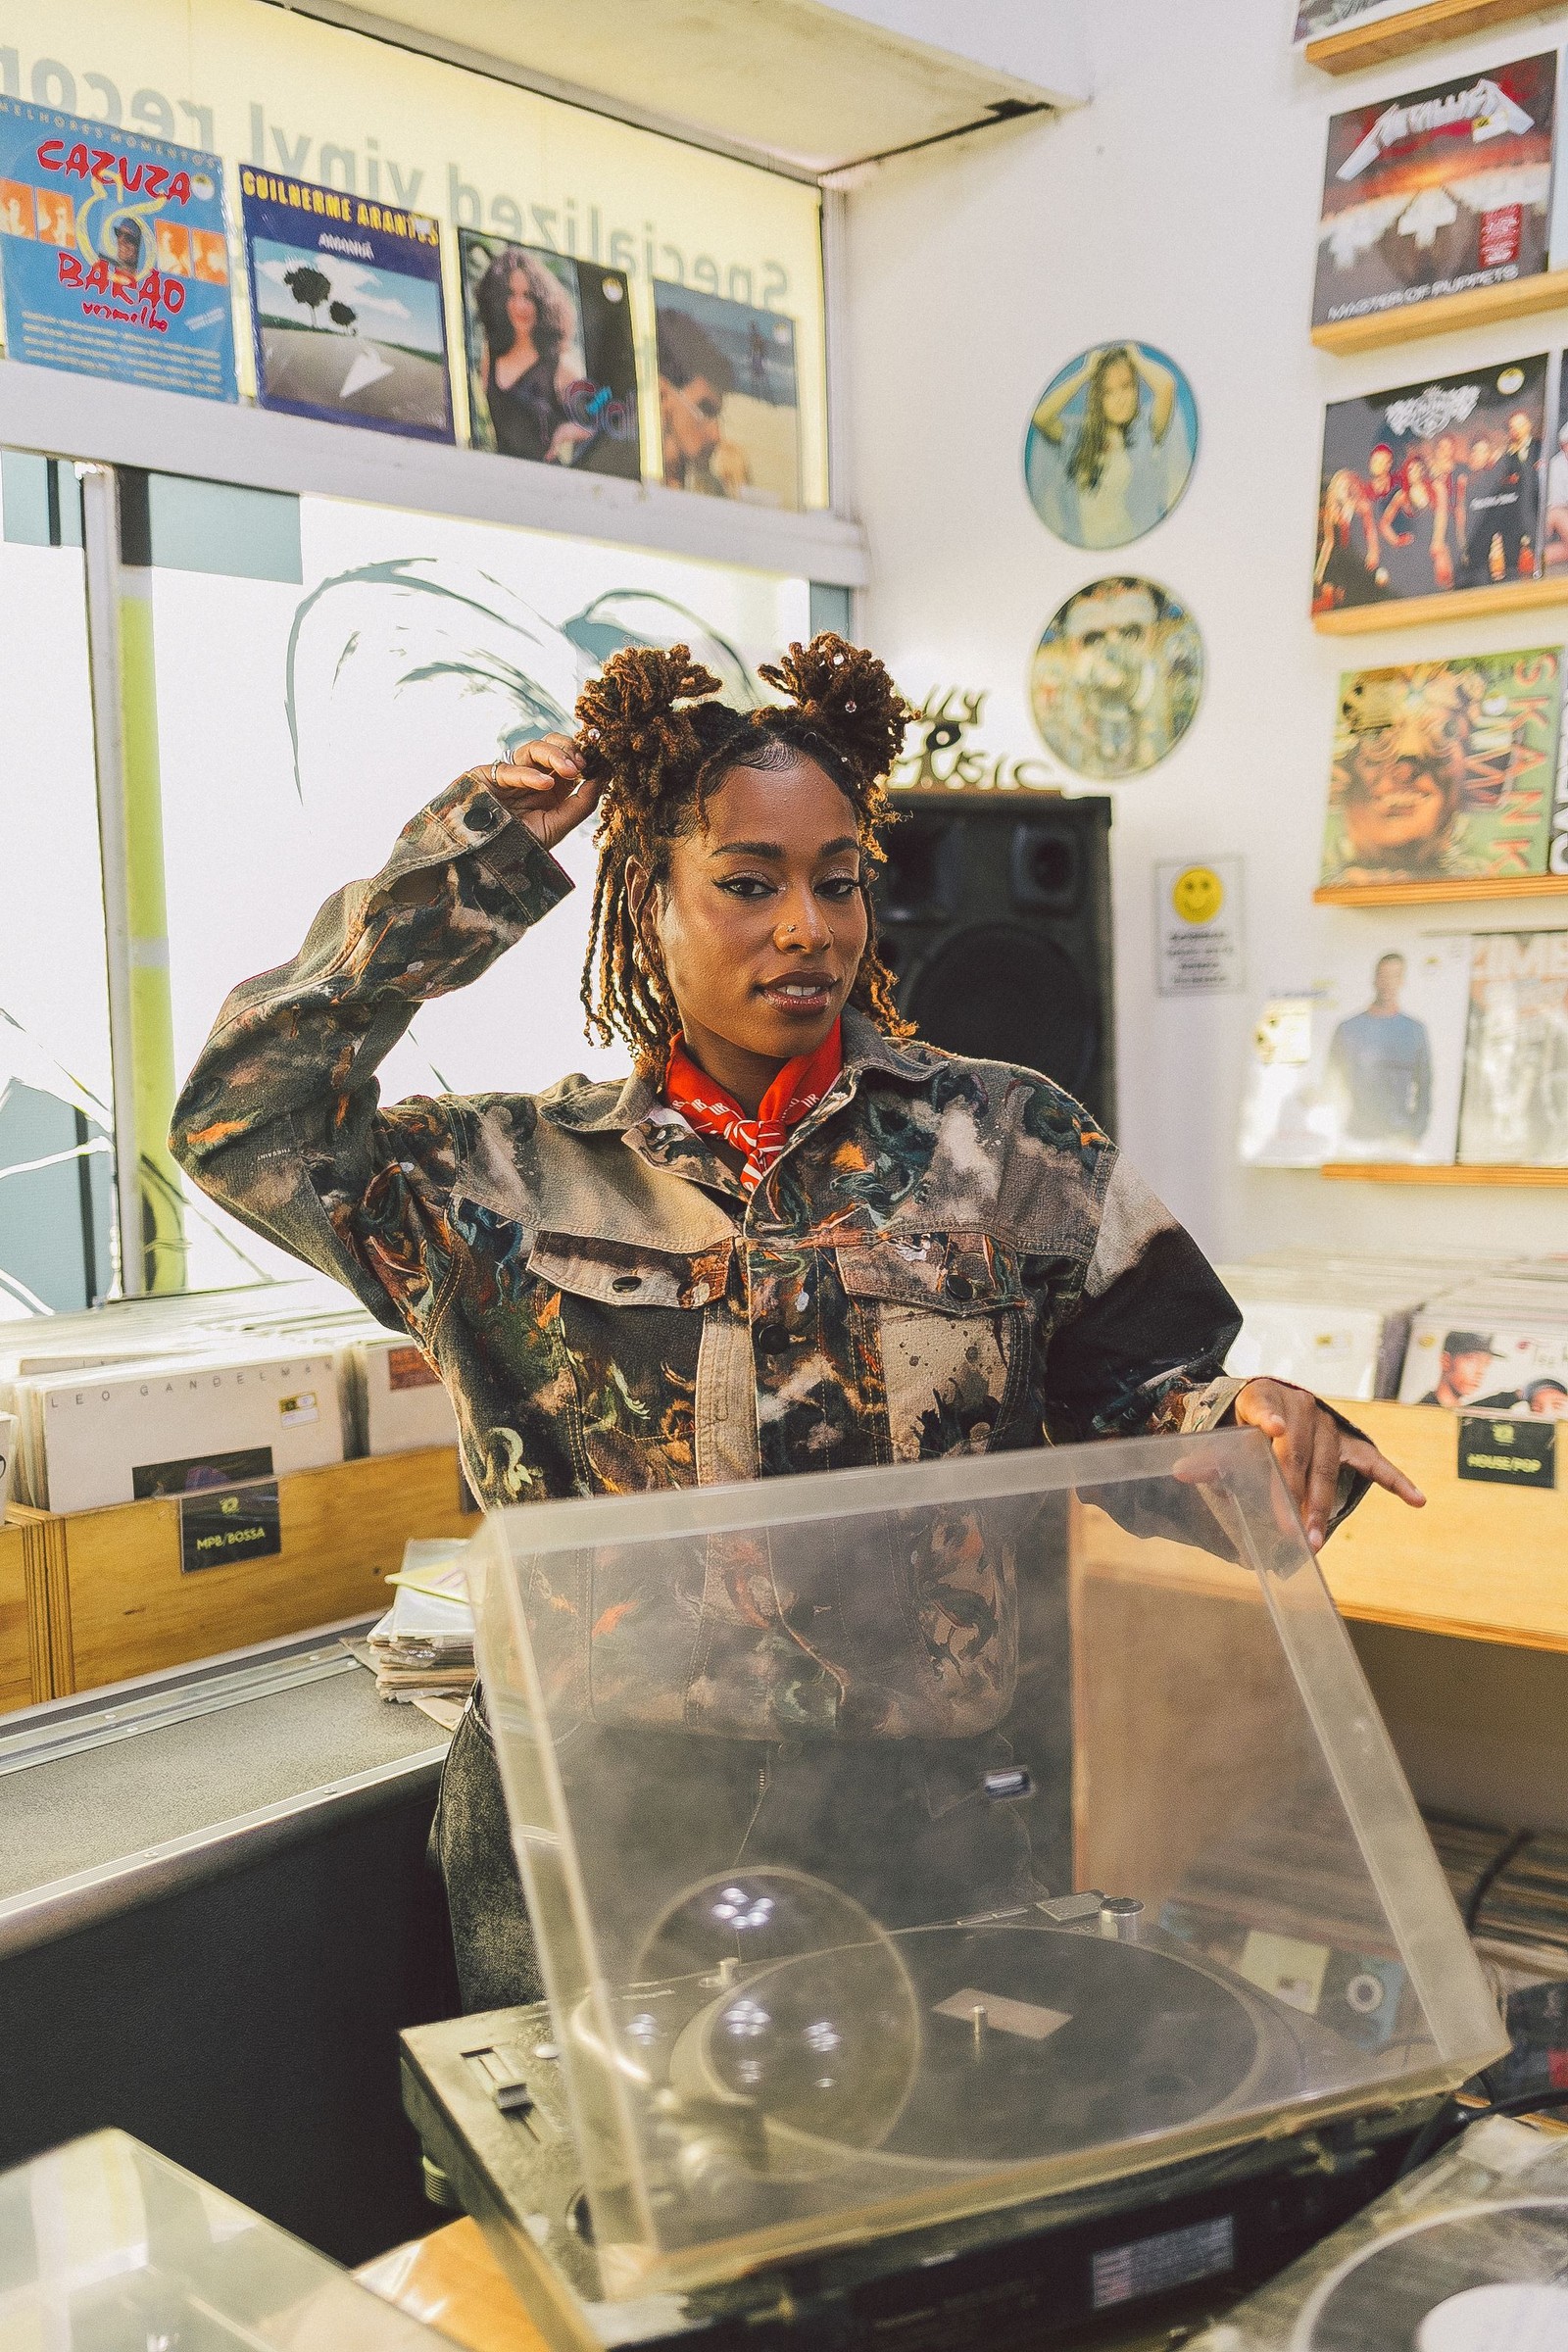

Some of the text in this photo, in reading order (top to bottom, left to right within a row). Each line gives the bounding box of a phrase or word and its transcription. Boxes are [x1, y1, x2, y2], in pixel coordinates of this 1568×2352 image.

[36, 139, 192, 206] CAZUZA
[242, 171, 353, 222] GUILHERME
[1486, 653, 1558, 874] SKANK
[51, 1360, 334, 1409] LEO GANDELMAN
[196, 1526, 267, 1550] MPB/BOSSA
